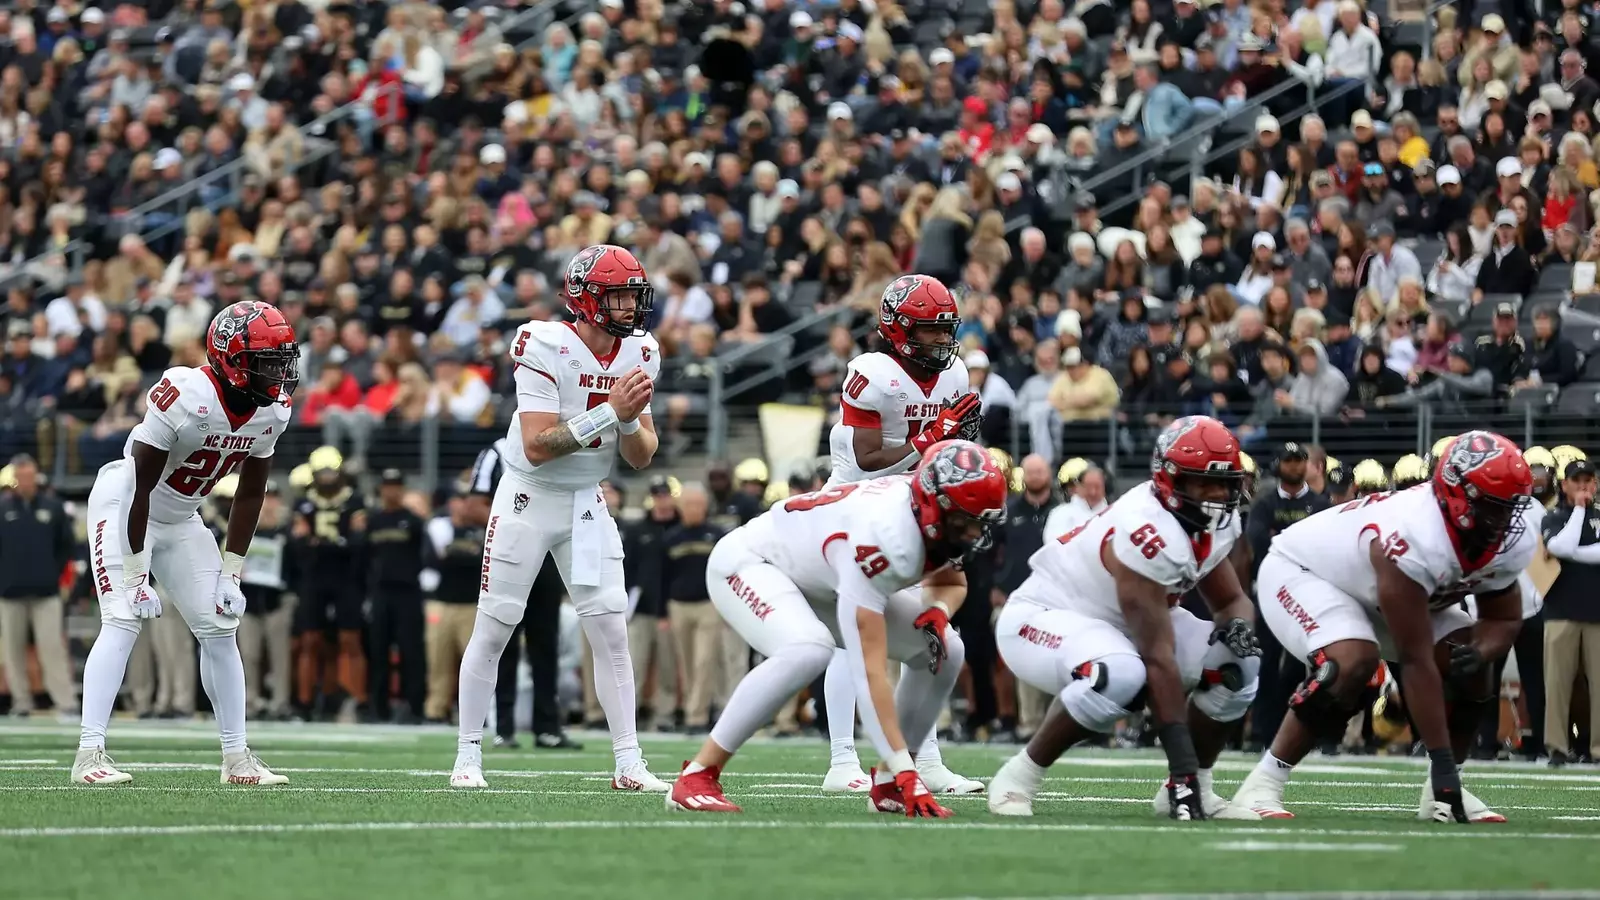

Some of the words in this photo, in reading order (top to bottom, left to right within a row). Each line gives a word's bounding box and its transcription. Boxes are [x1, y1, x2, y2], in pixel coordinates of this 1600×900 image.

[514, 331, 531, 357] 5
[150, 377, 180, 412] 20
[579, 373, 594, 388] NC
[596, 375, 620, 390] STA
[845, 369, 869, 400] 10
[904, 404, 918, 418] NC
[921, 403, 942, 418] STA
[203, 434, 220, 448] NC
[220, 436, 256, 450] STATE
[95, 519, 113, 596] WOLFPACK
[481, 515, 500, 593] WOLFPACK
[1130, 523, 1167, 559] 66
[855, 544, 890, 579] 49
[726, 572, 776, 621] WOLFPACK
